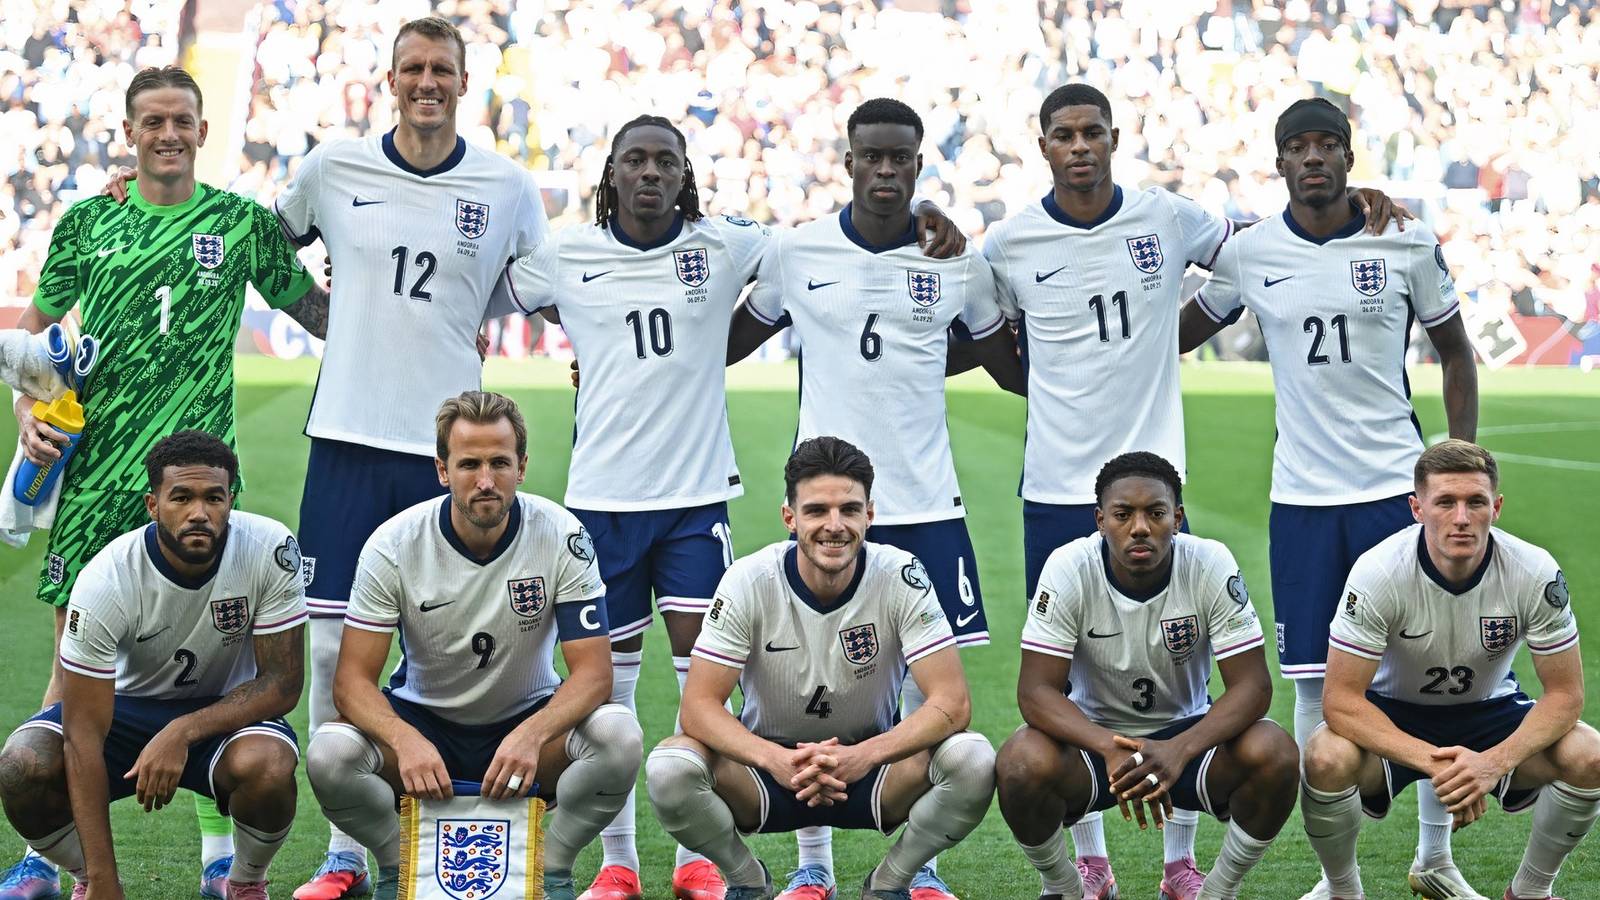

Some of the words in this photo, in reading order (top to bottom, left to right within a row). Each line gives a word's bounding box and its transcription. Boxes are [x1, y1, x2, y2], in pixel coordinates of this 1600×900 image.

[457, 240, 479, 249] ANDORRA
[391, 245, 438, 302] 12
[685, 288, 708, 296] ANDORRA
[1141, 274, 1162, 284] ANDORRA
[155, 285, 172, 335] 1
[687, 295, 707, 304] 06.09.25
[1088, 290, 1132, 342] 11
[1362, 305, 1383, 313] 06.09.25
[625, 307, 674, 360] 10
[859, 313, 883, 362] 6
[1303, 314, 1351, 366] 21
[958, 556, 975, 607] 6
[579, 604, 601, 630] C
[174, 648, 200, 688] 2
[471, 631, 496, 670] 9
[1131, 677, 1156, 713] 3
[1419, 665, 1476, 696] 23
[805, 685, 832, 719] 4
